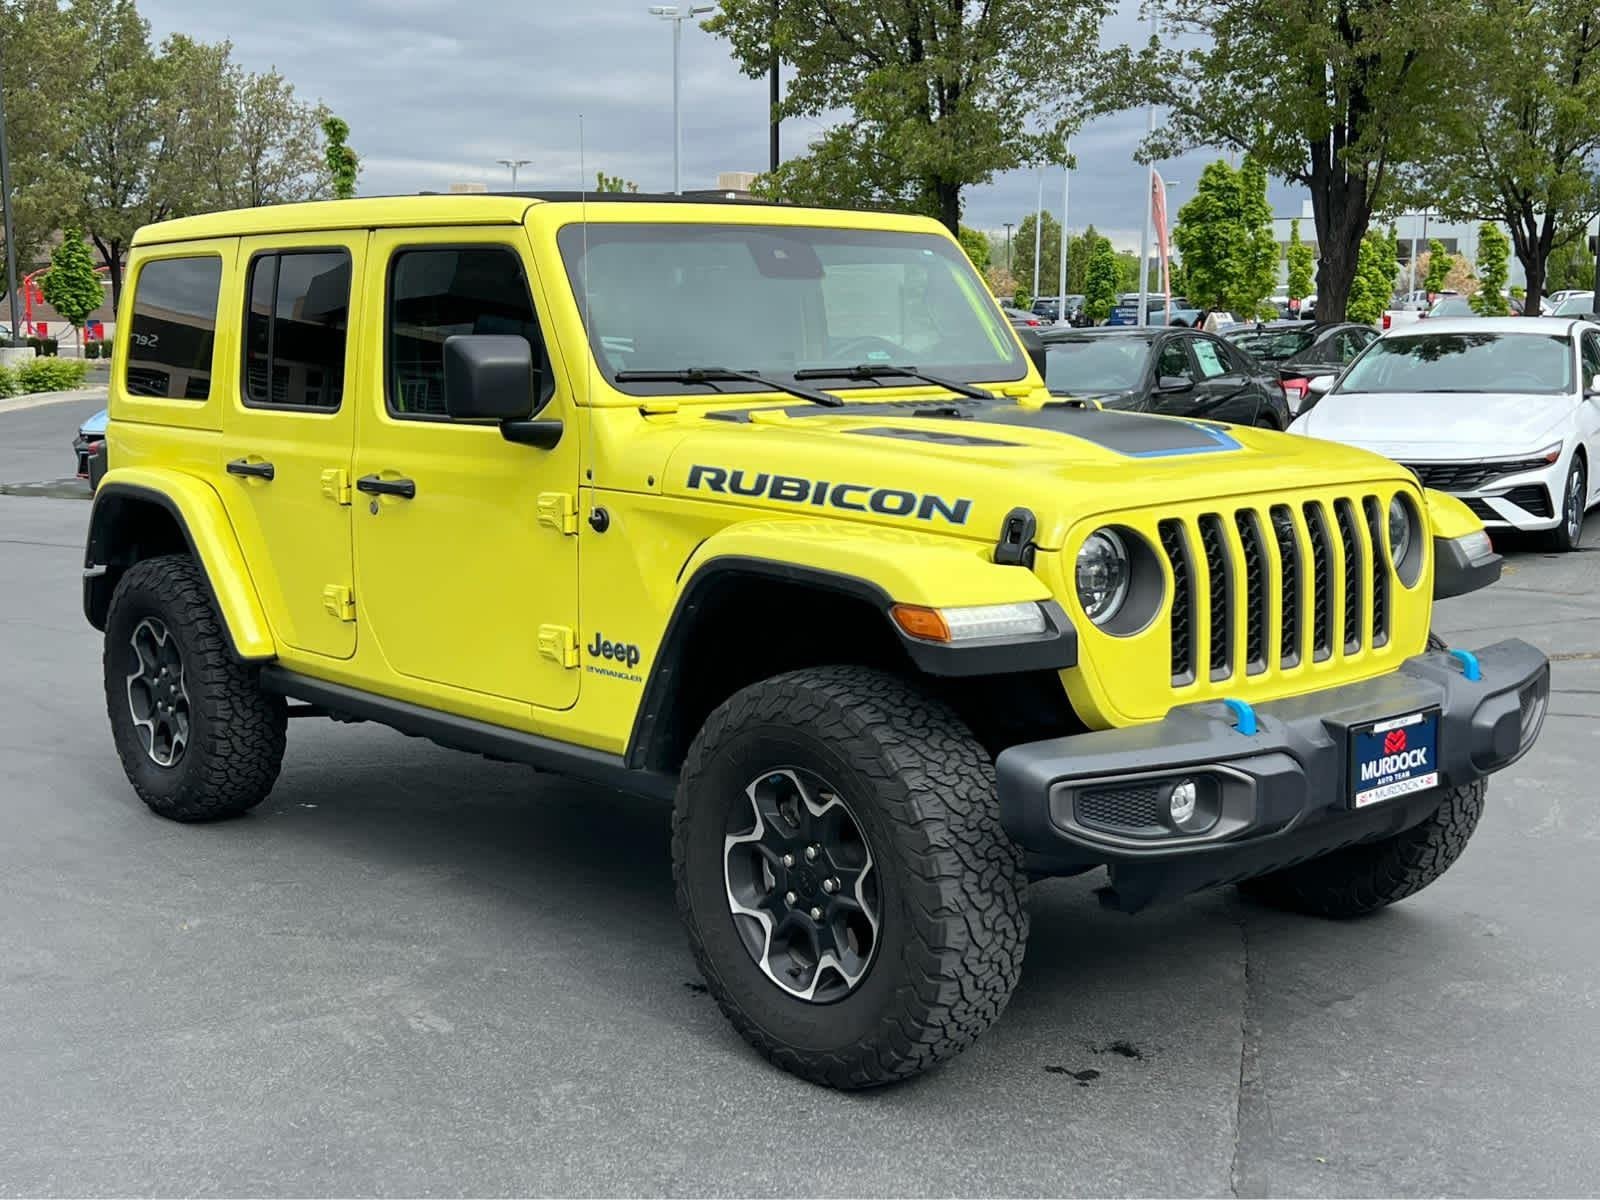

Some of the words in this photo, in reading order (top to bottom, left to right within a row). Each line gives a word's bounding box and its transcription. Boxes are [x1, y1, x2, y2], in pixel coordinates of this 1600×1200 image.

[686, 465, 973, 525] RUBICON
[587, 631, 640, 669] Jeep
[594, 667, 642, 682] WRANGLER
[1361, 746, 1428, 781] MURDOCK
[1374, 780, 1419, 799] MURDOCK
[1377, 774, 1394, 785] AUTO
[1394, 770, 1411, 781] TEAM
